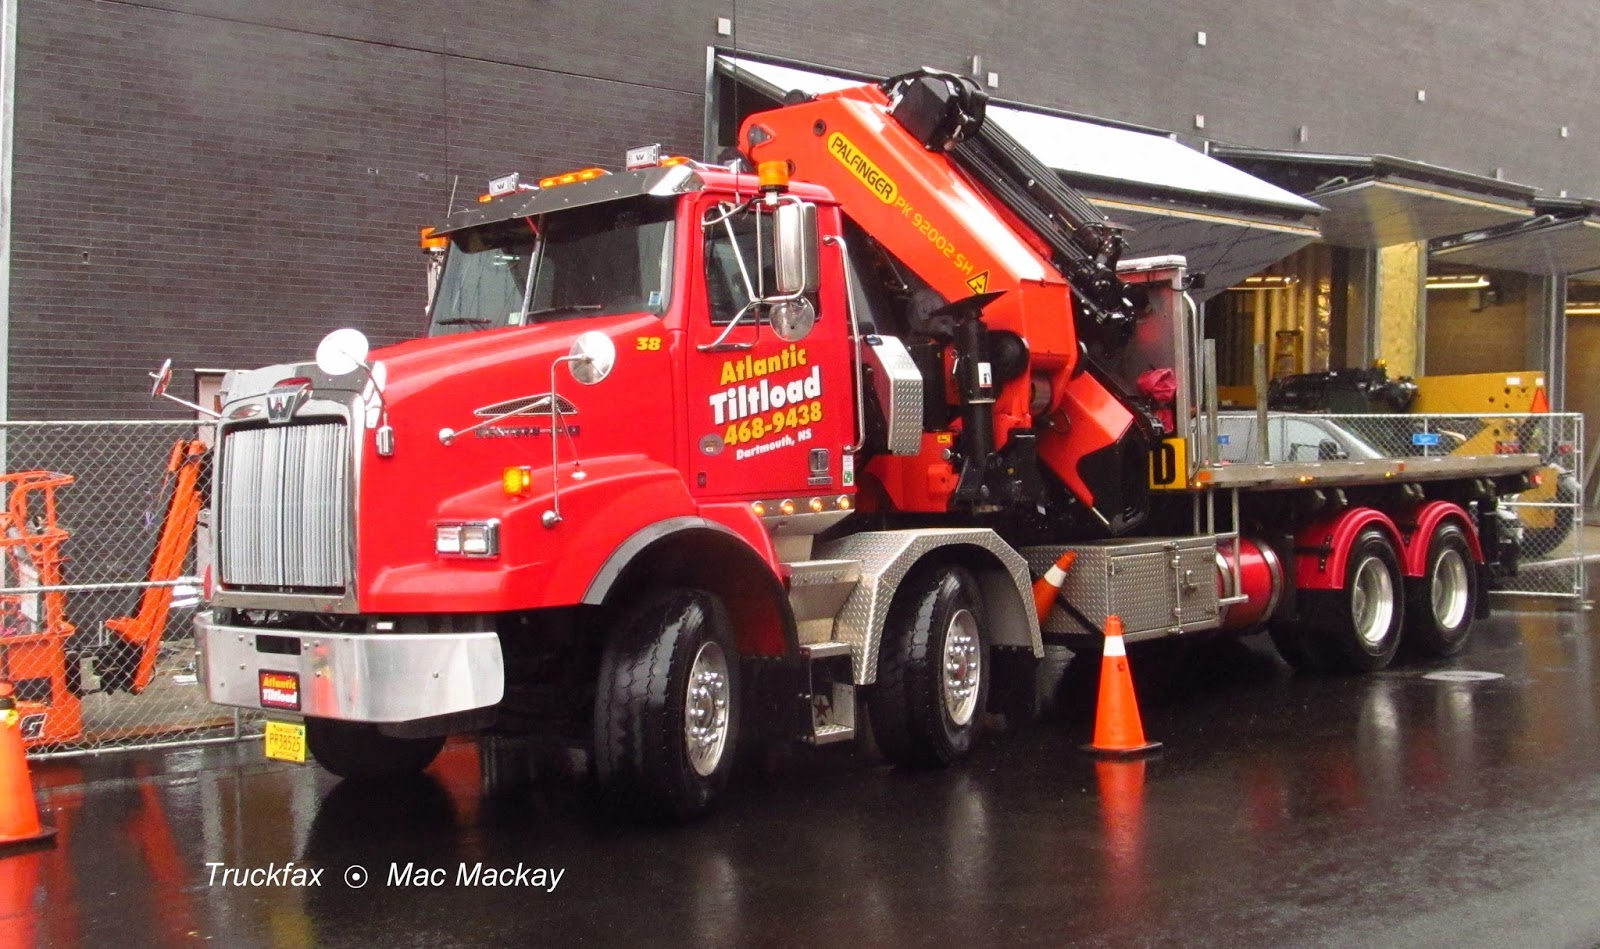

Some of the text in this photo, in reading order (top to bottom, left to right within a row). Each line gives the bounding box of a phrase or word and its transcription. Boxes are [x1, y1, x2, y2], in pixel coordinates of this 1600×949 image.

[831, 136, 893, 200] PALFINGER
[894, 196, 913, 218] PK
[636, 337, 661, 350] 38
[720, 344, 807, 386] Atlantic
[709, 365, 821, 425] Tiltload
[724, 401, 822, 446] 468-9438
[736, 428, 812, 461] Dartmouth, NS
[263, 676, 296, 690] Atlantic
[263, 688, 297, 703] Tiltload
